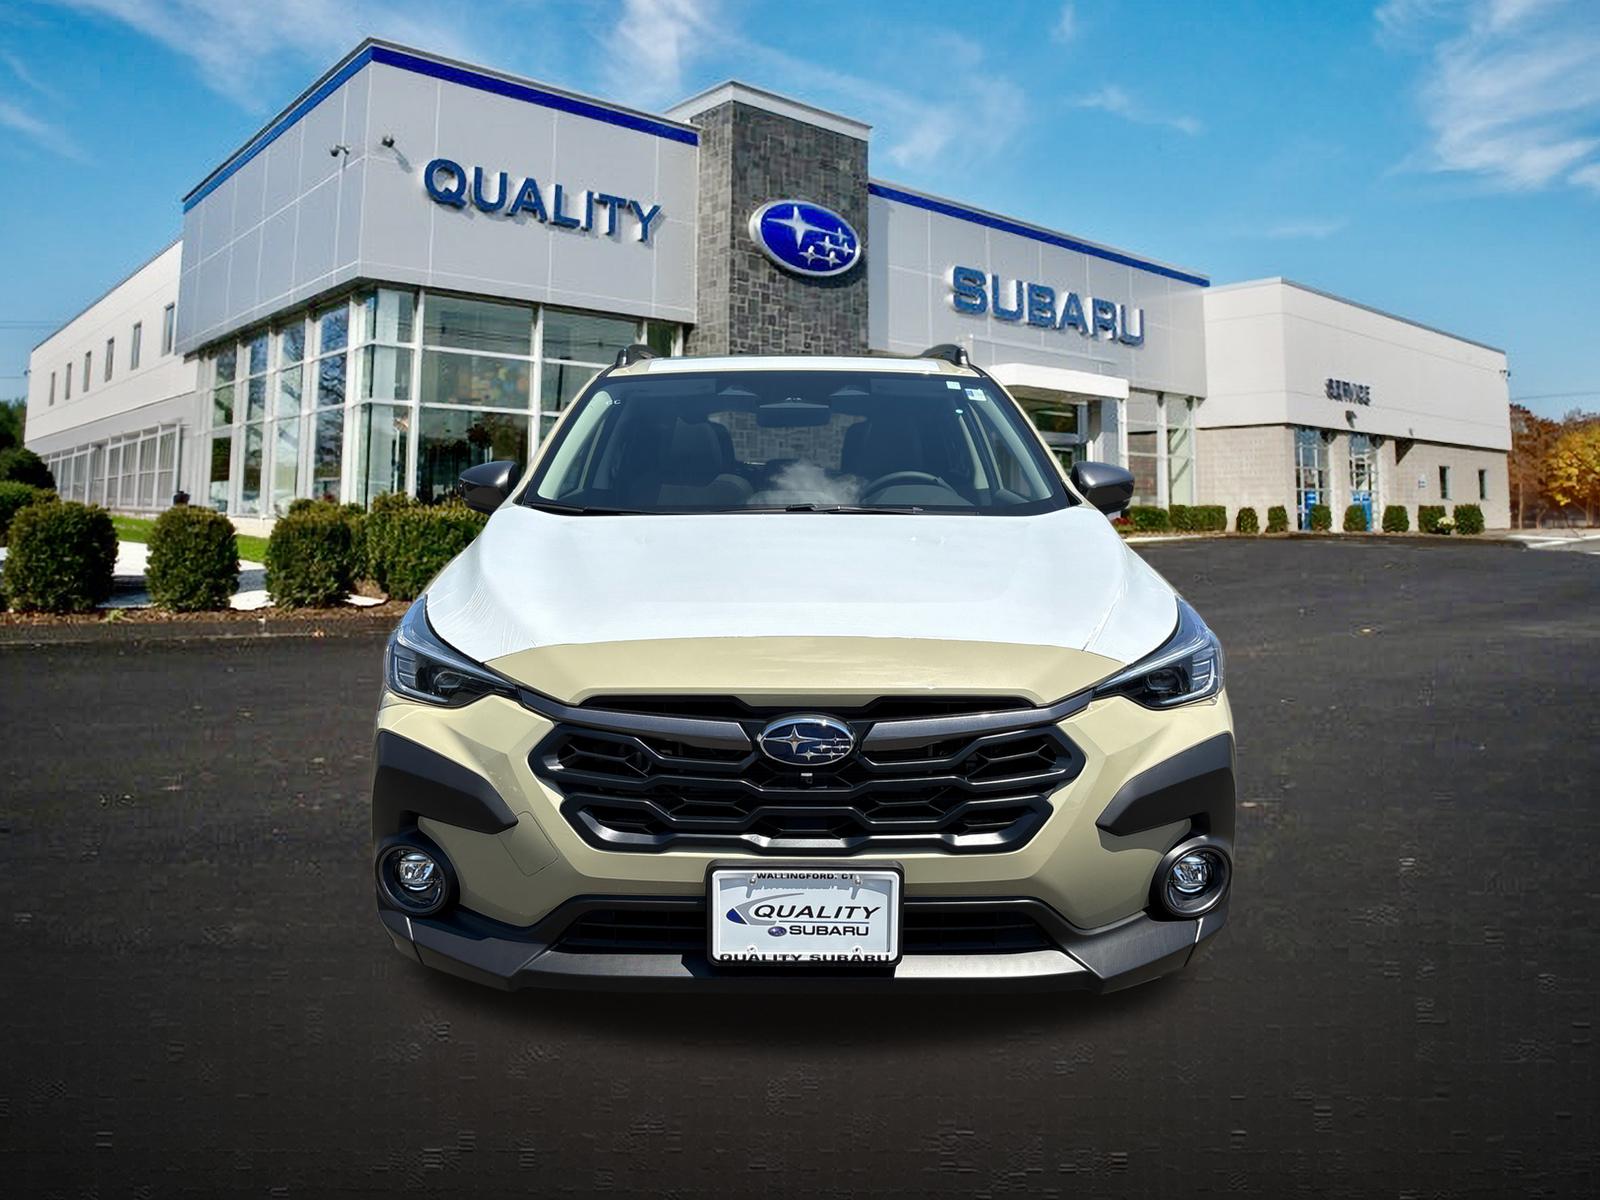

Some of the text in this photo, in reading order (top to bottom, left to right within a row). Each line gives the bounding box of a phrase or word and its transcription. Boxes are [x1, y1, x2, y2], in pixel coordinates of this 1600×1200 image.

[424, 158, 661, 242] QUALITY
[951, 265, 1145, 346] SUBARU
[753, 904, 881, 919] QUALITY
[789, 925, 869, 936] SUBARU
[720, 953, 890, 962] QUALITY SUBARU
